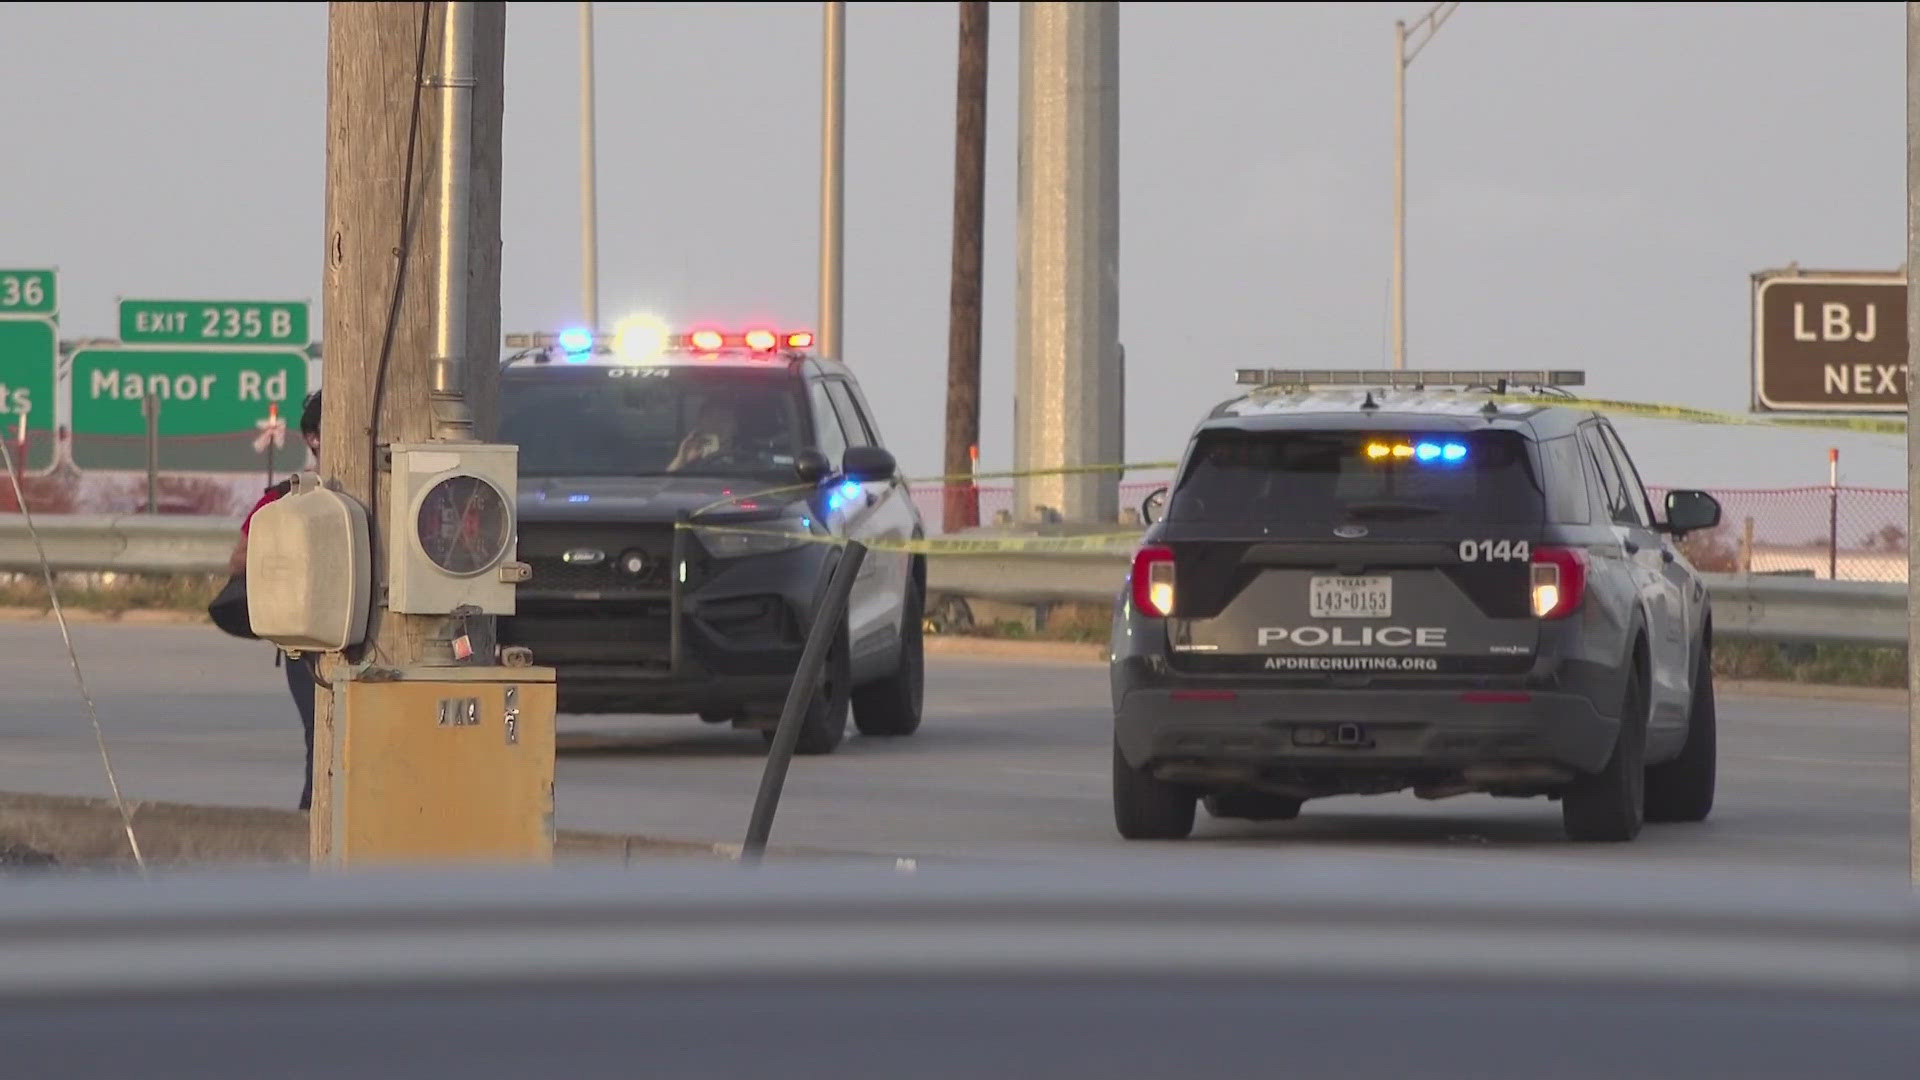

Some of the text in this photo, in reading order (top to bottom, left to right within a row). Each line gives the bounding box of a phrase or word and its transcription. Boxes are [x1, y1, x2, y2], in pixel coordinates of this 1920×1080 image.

[135, 308, 292, 338] EXIT 235 B
[1794, 302, 1877, 342] LBJ
[90, 369, 288, 400] Manor Rd
[1459, 539, 1530, 562] 0144
[1336, 579, 1367, 587] TEXAS
[1257, 627, 1447, 646] POLICE
[1264, 657, 1437, 670] APDRECRUITING.ORG
